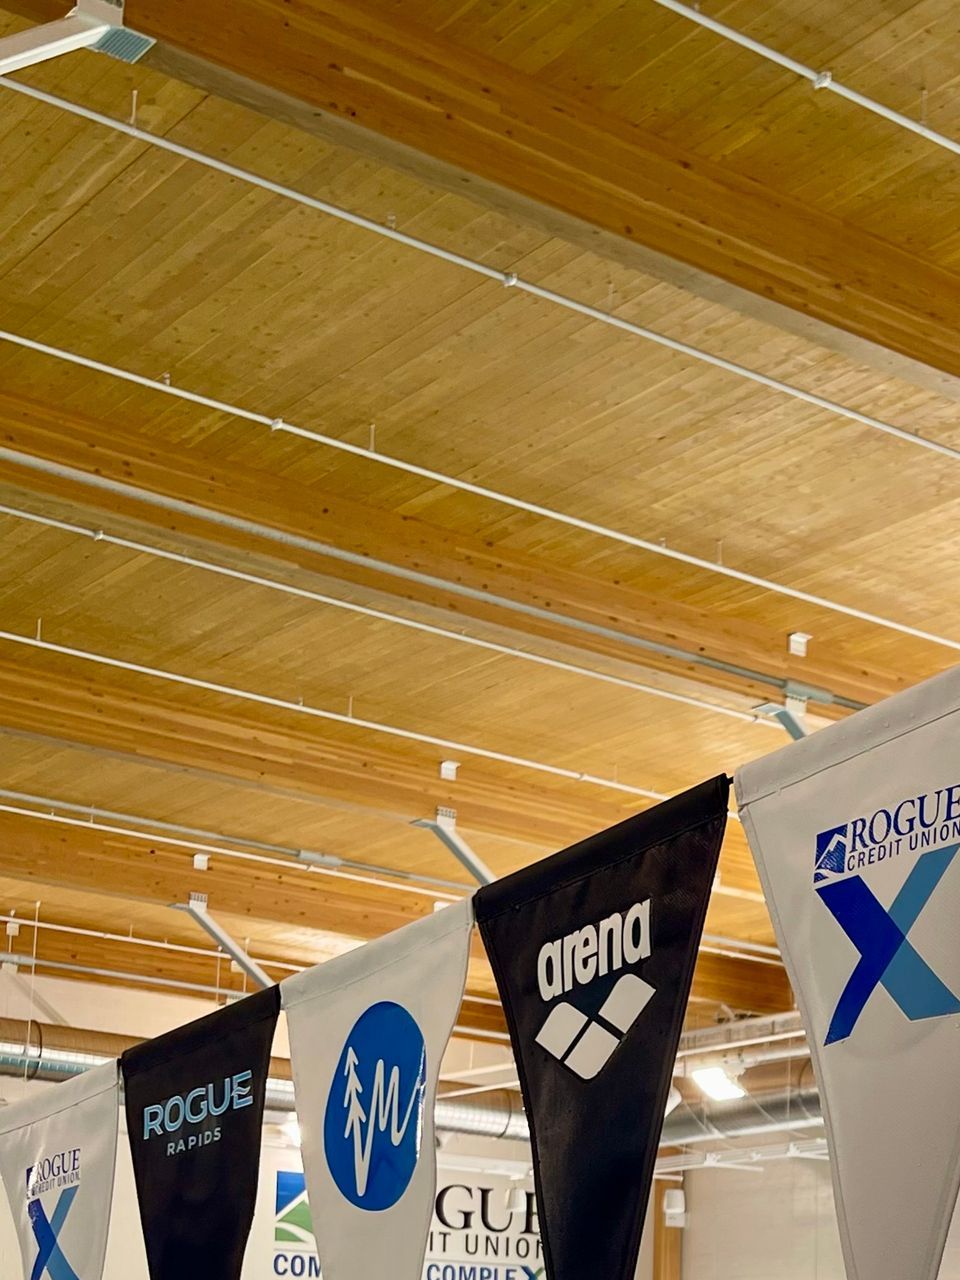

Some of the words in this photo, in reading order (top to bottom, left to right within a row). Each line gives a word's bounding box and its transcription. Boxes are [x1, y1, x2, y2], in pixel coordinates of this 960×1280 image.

[847, 838, 903, 871] CREDIT
[537, 898, 652, 1002] arena
[143, 1069, 254, 1140] ROGUE
[166, 1127, 222, 1156] RAPIDS
[36, 1148, 81, 1184] ROGUE
